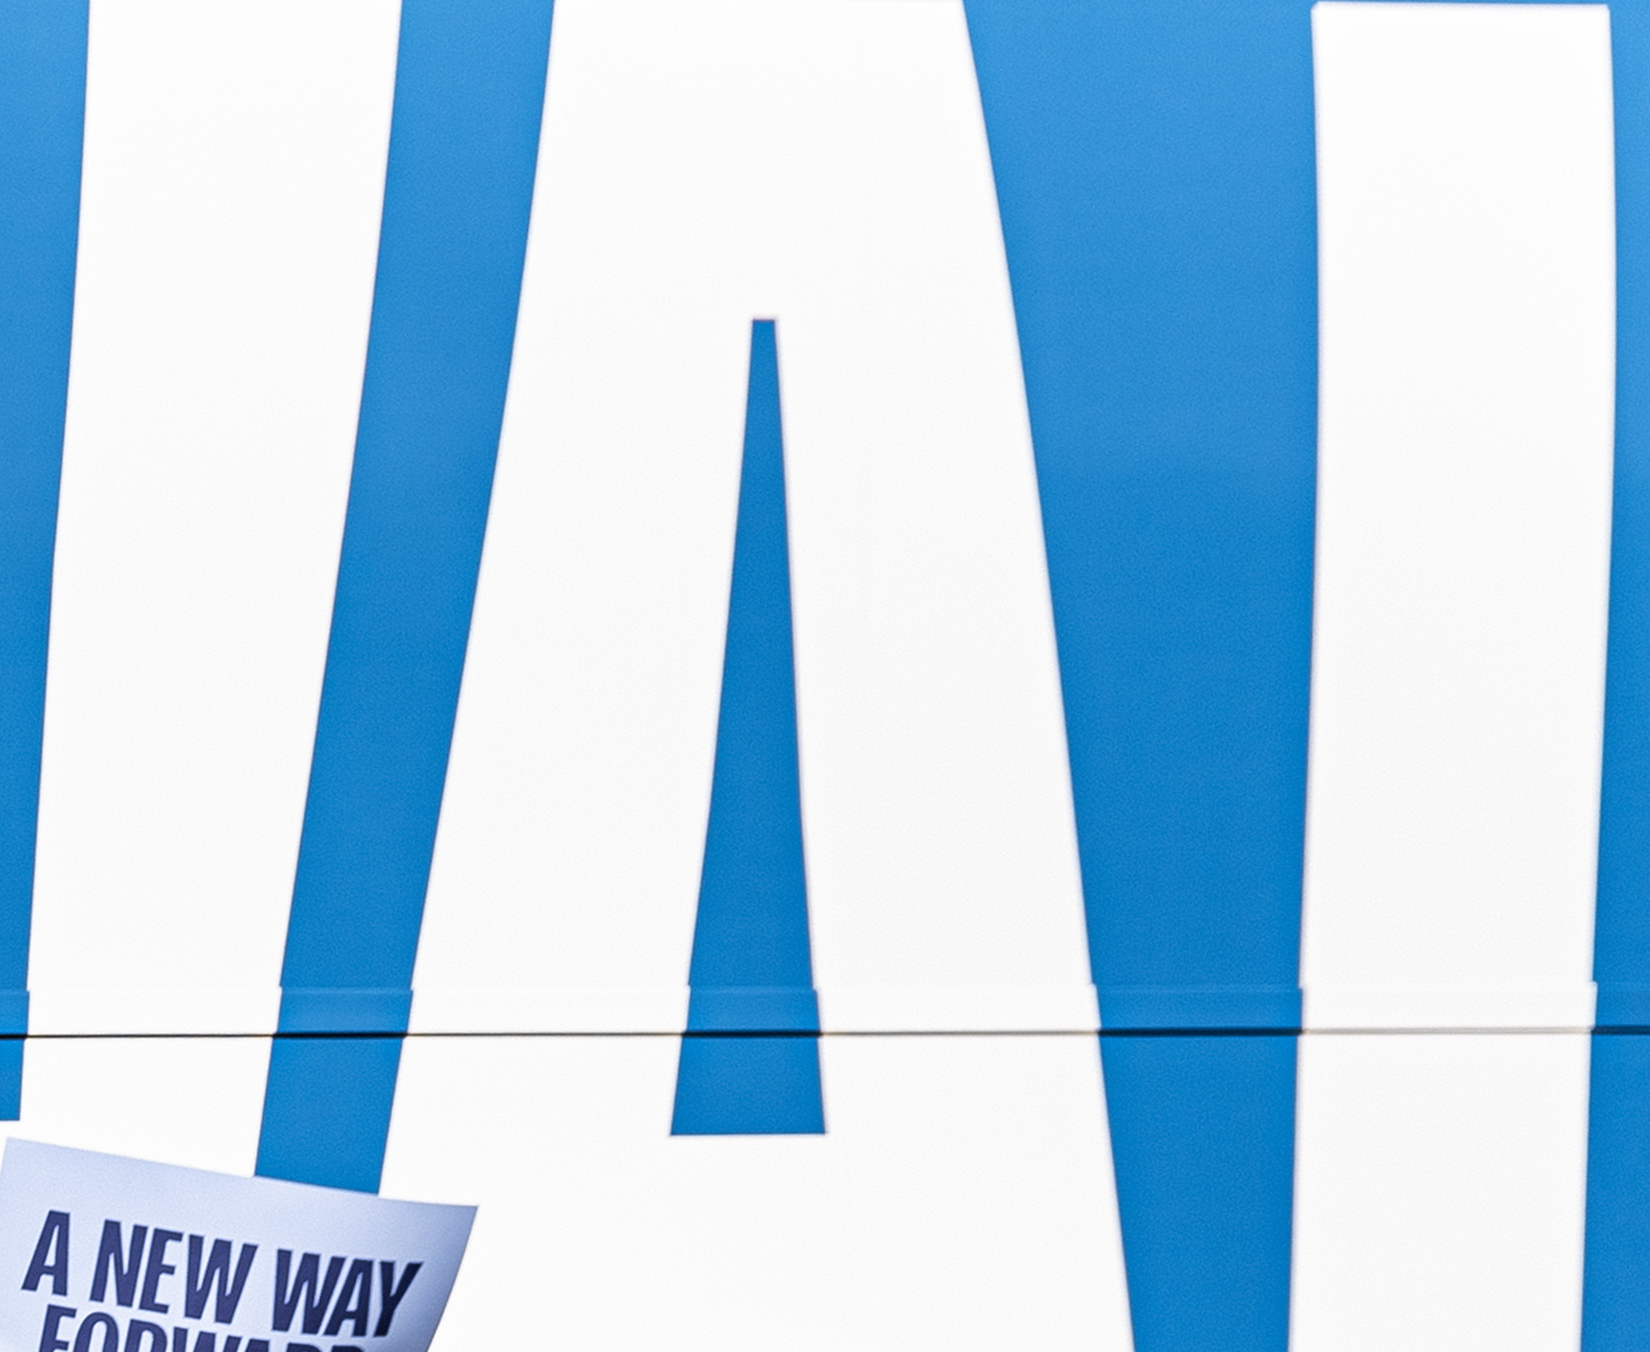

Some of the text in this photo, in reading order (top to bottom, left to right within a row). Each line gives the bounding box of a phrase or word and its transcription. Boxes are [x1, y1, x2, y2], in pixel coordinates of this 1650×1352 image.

[20, 1209, 424, 1338] A NEW WAY
